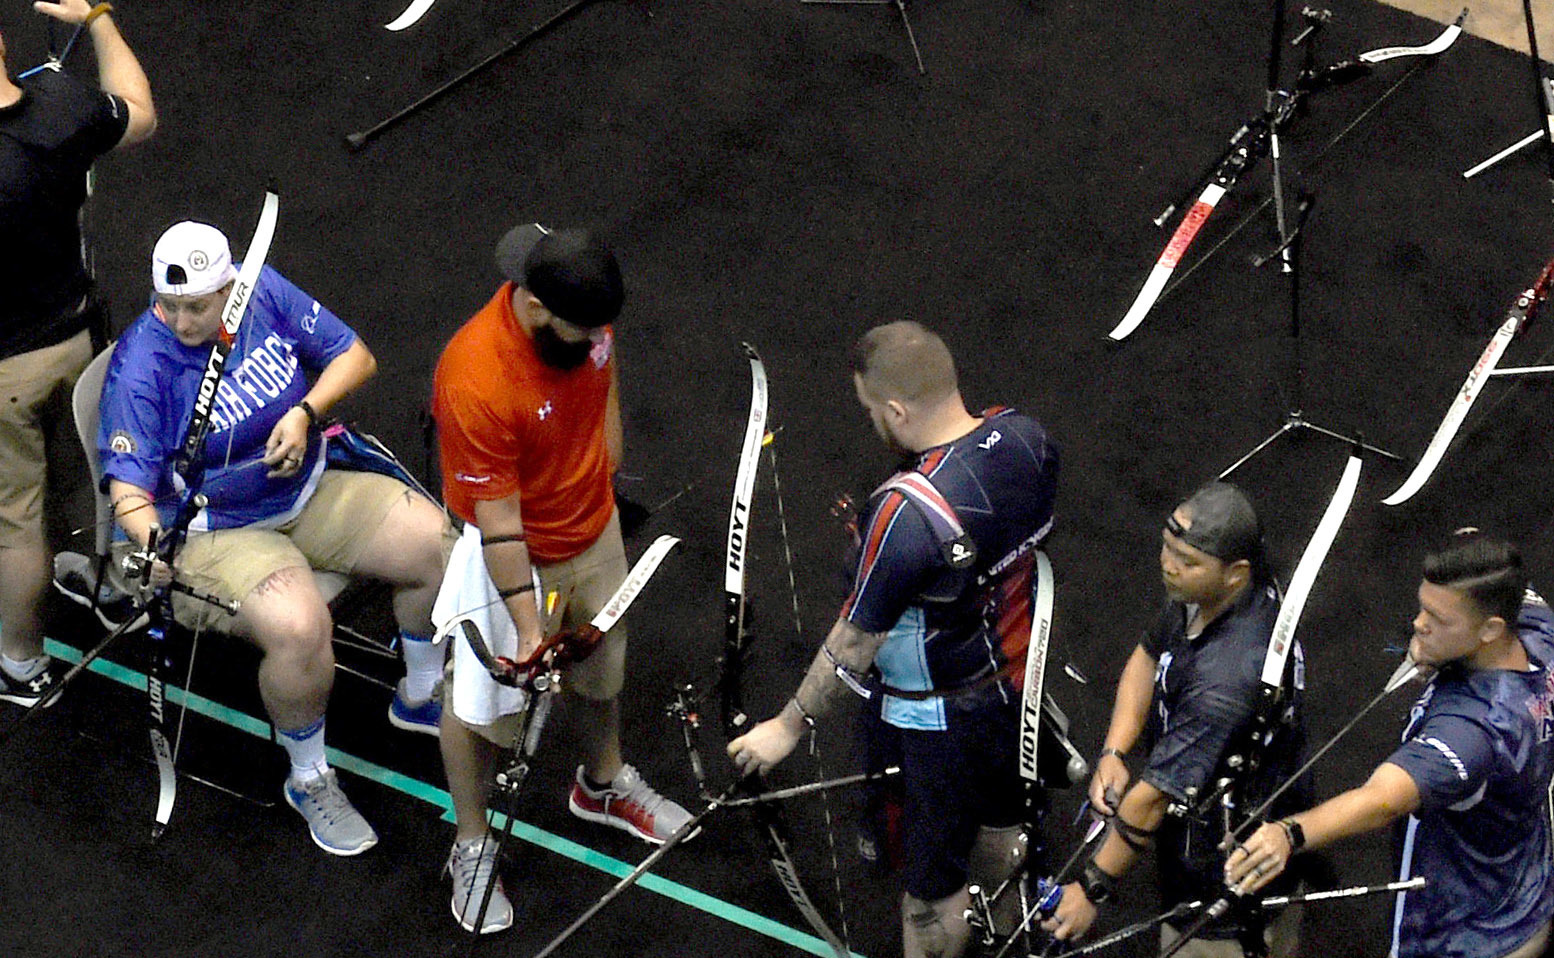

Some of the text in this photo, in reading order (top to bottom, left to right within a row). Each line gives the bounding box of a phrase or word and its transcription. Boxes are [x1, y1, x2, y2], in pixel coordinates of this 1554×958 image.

[194, 345, 224, 417] HOYT
[728, 495, 747, 572] HOYT
[149, 675, 164, 724] HOYT
[1022, 699, 1037, 773] HOYT
